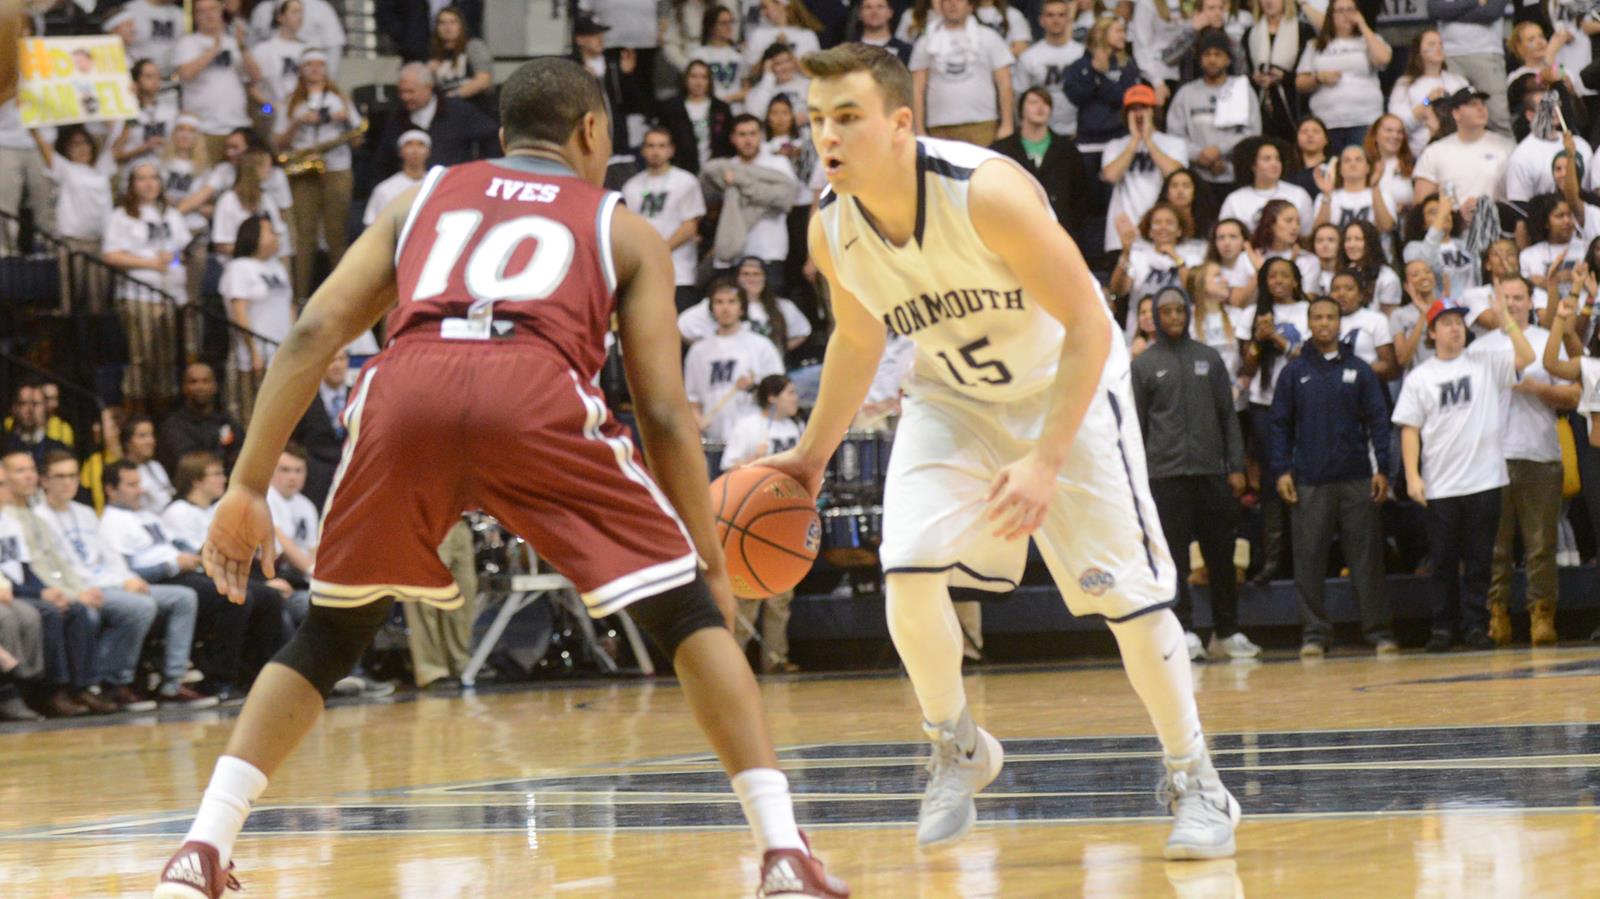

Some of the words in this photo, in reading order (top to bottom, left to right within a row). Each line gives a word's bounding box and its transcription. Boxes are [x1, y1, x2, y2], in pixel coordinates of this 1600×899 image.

[485, 177, 560, 203] IVES
[412, 208, 576, 302] 10
[710, 359, 737, 386] M
[936, 335, 1013, 386] 15
[1437, 375, 1472, 408] M
